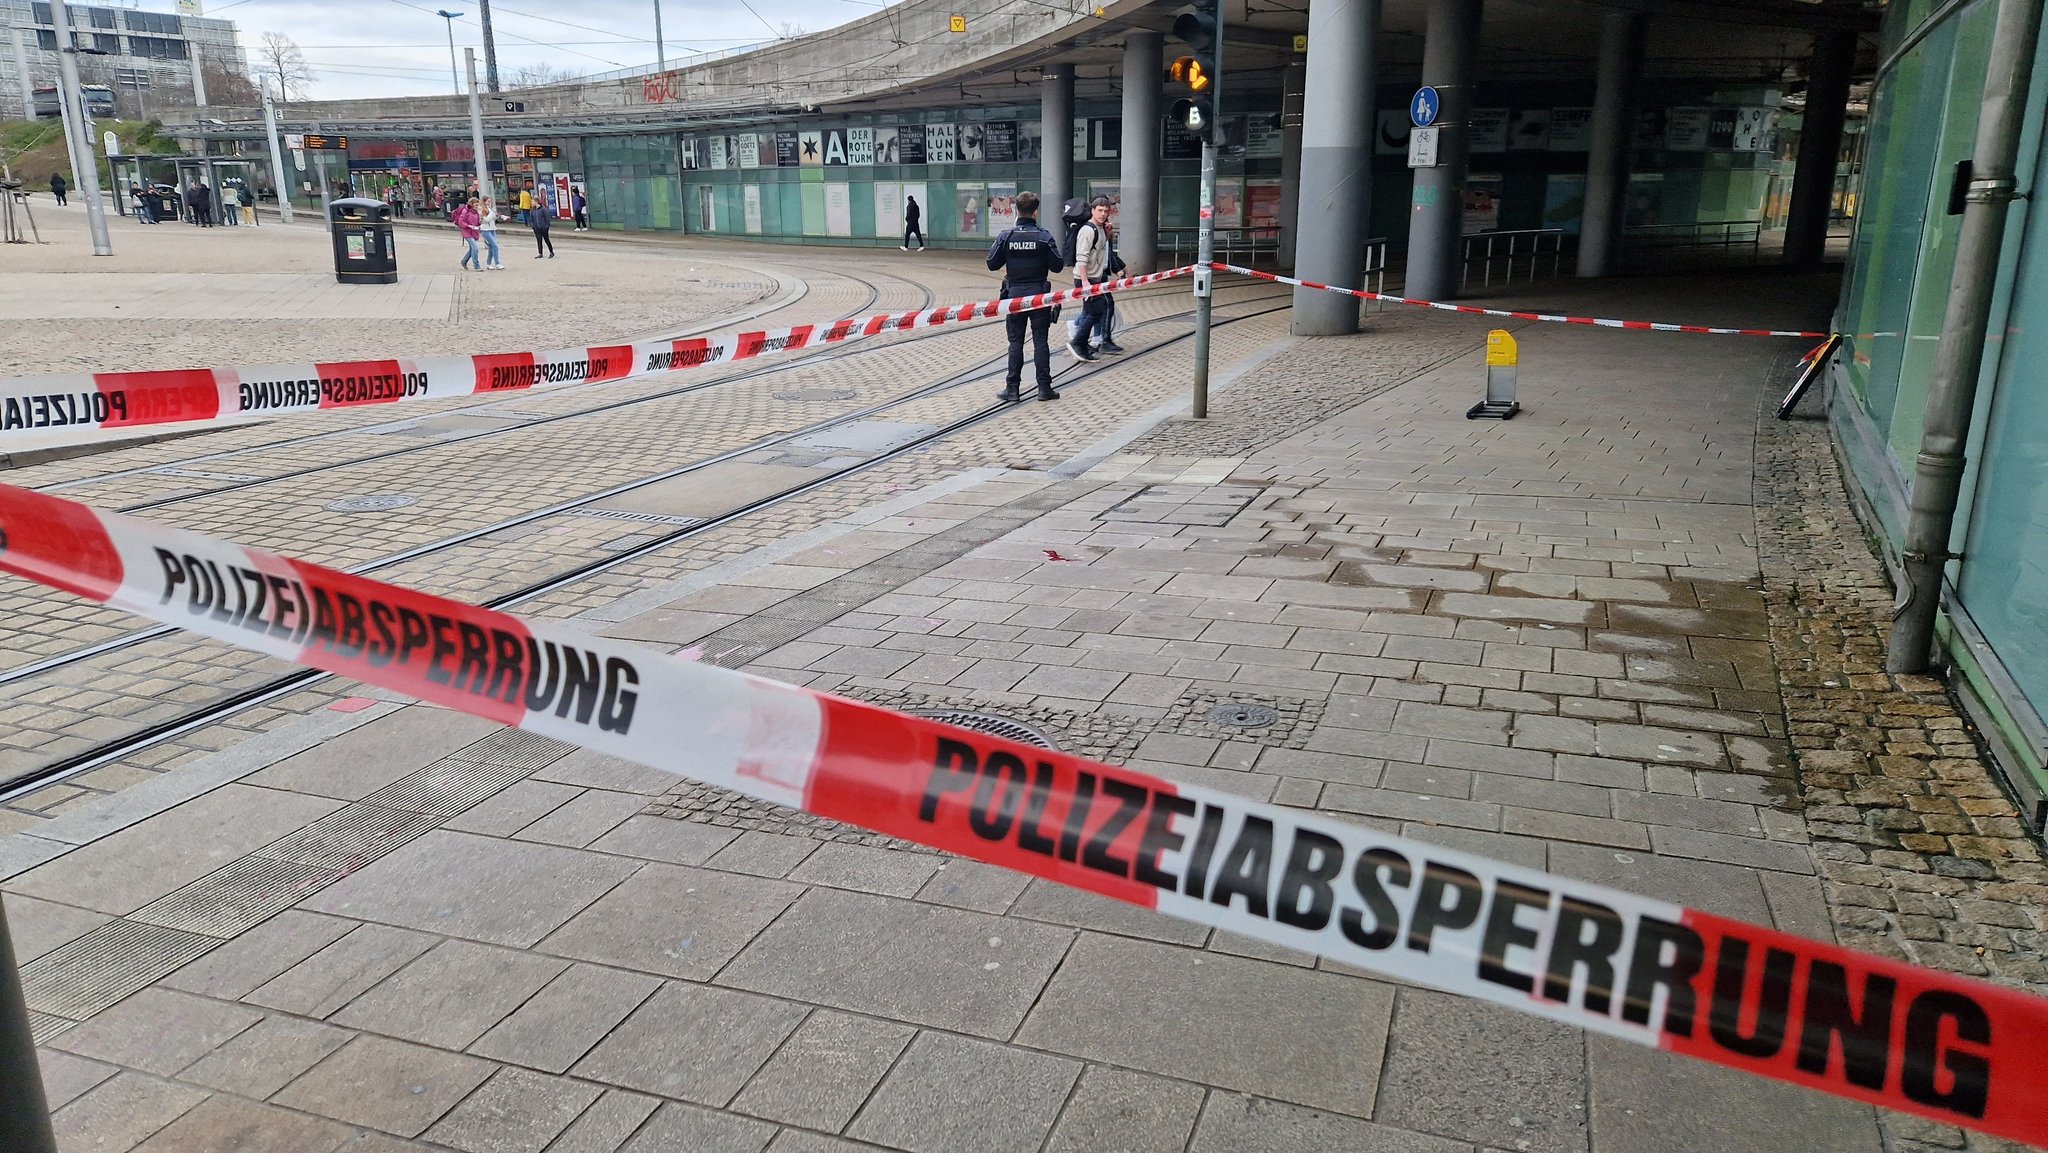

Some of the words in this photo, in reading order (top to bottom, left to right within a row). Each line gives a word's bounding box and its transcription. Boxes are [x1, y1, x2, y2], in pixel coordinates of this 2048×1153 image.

[852, 130, 868, 140] DER
[927, 126, 953, 136] HAL
[928, 139, 953, 149] LUN
[1095, 121, 1118, 158] L
[824, 131, 847, 164] A
[849, 142, 872, 152] ROTE
[682, 140, 695, 168] H
[849, 154, 872, 163] TURM
[928, 151, 953, 161] KEN
[1009, 241, 1036, 250] POLIZEI
[154, 545, 640, 736] POLIZEIABSPERRUNG
[917, 735, 1991, 1120] POLIZEIABSPERRUNG
